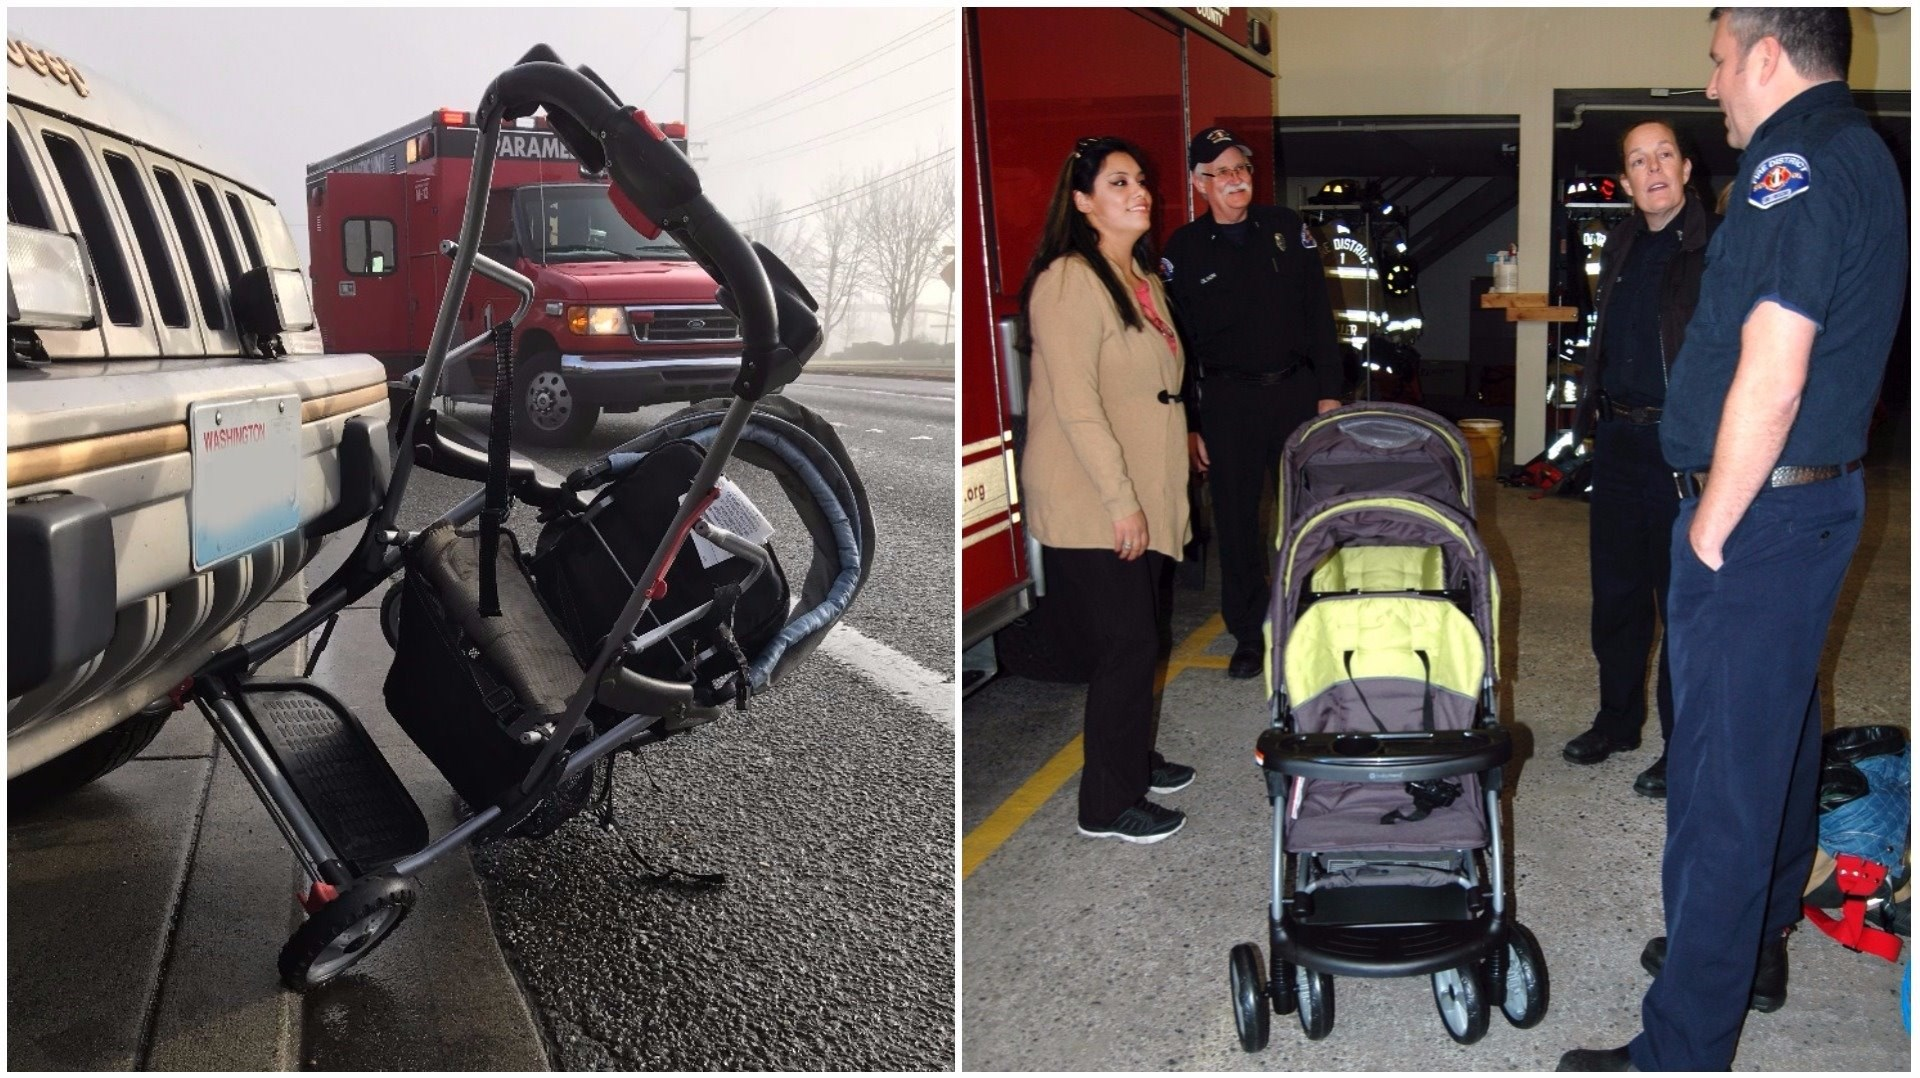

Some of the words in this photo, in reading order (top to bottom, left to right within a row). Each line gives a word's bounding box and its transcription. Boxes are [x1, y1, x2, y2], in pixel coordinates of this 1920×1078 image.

[1768, 156, 1808, 172] DISTRICT
[1340, 252, 1346, 265] 1
[203, 422, 266, 453] WASHINGTON
[964, 484, 985, 503] .org
